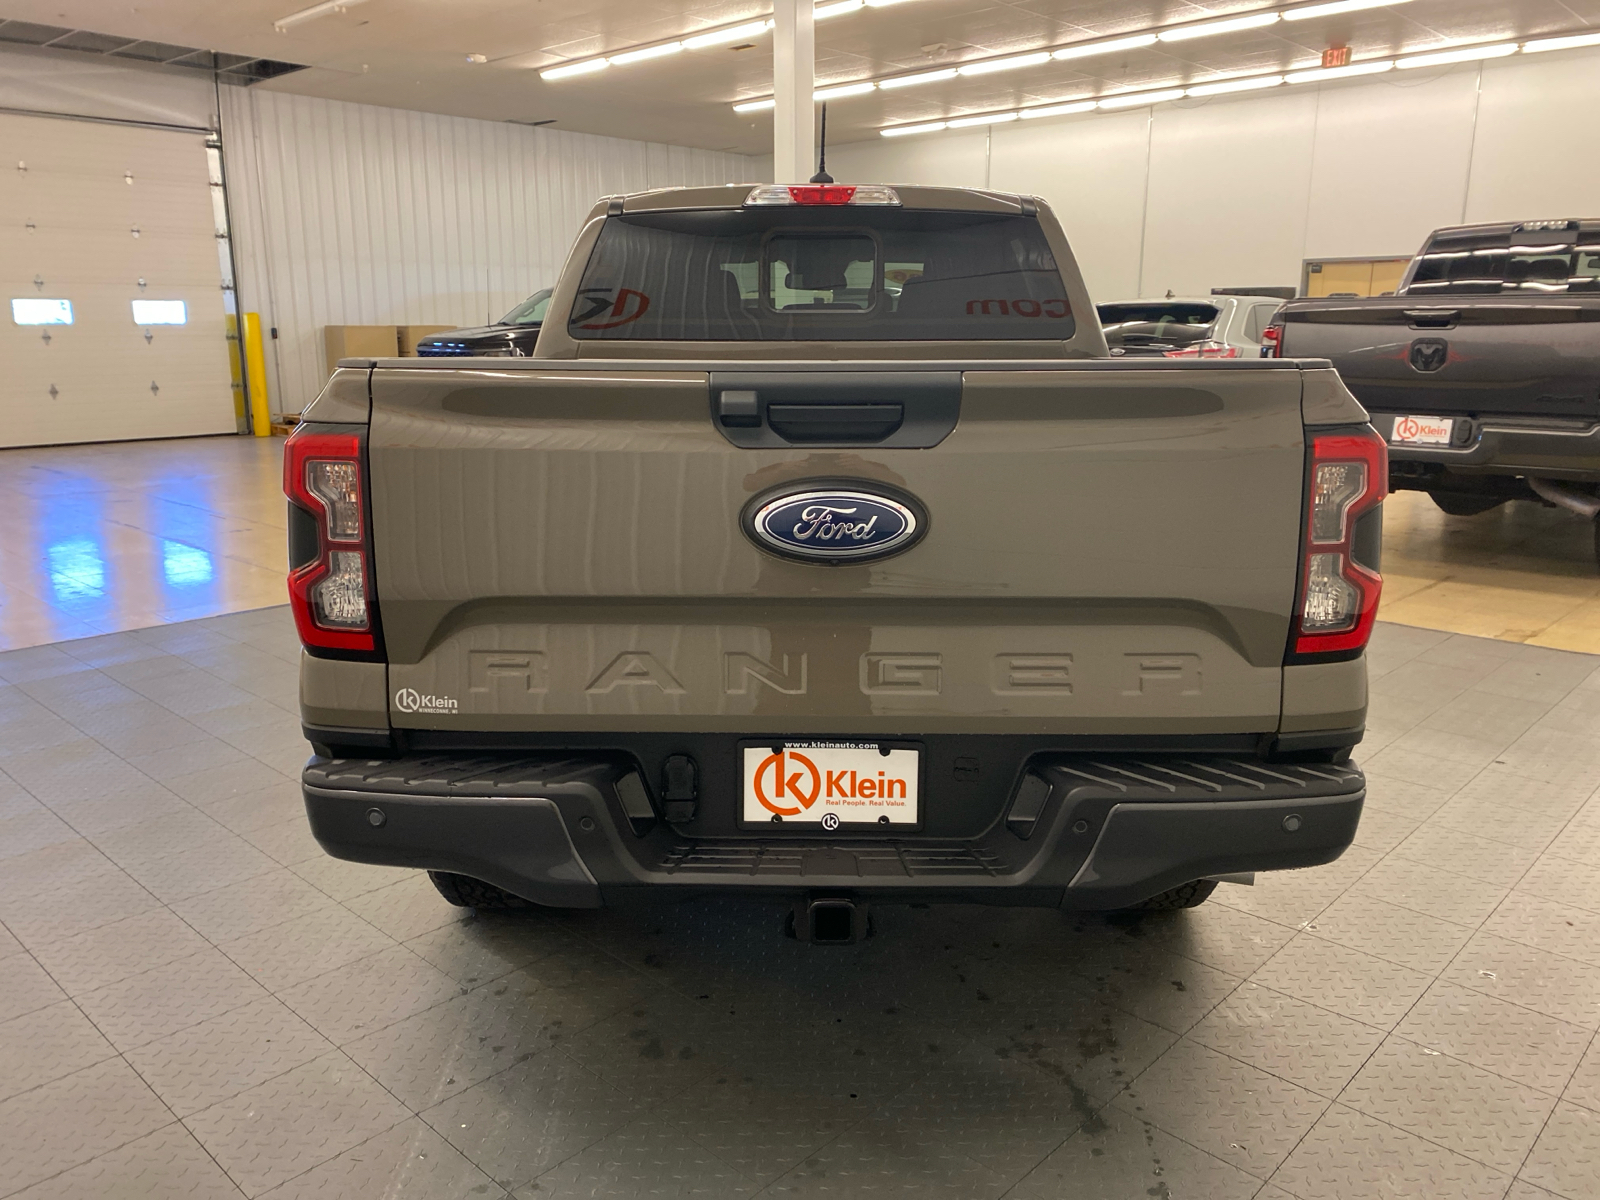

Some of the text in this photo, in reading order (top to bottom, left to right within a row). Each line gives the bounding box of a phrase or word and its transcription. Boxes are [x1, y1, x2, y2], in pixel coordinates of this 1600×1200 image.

[1326, 49, 1347, 67] EXIT
[1420, 425, 1447, 436] Klein
[793, 505, 878, 540] Ford
[468, 650, 1204, 696] RANGER
[421, 695, 458, 708] Klein
[784, 741, 879, 750] www.kleinauto.com
[826, 770, 907, 799] Klein
